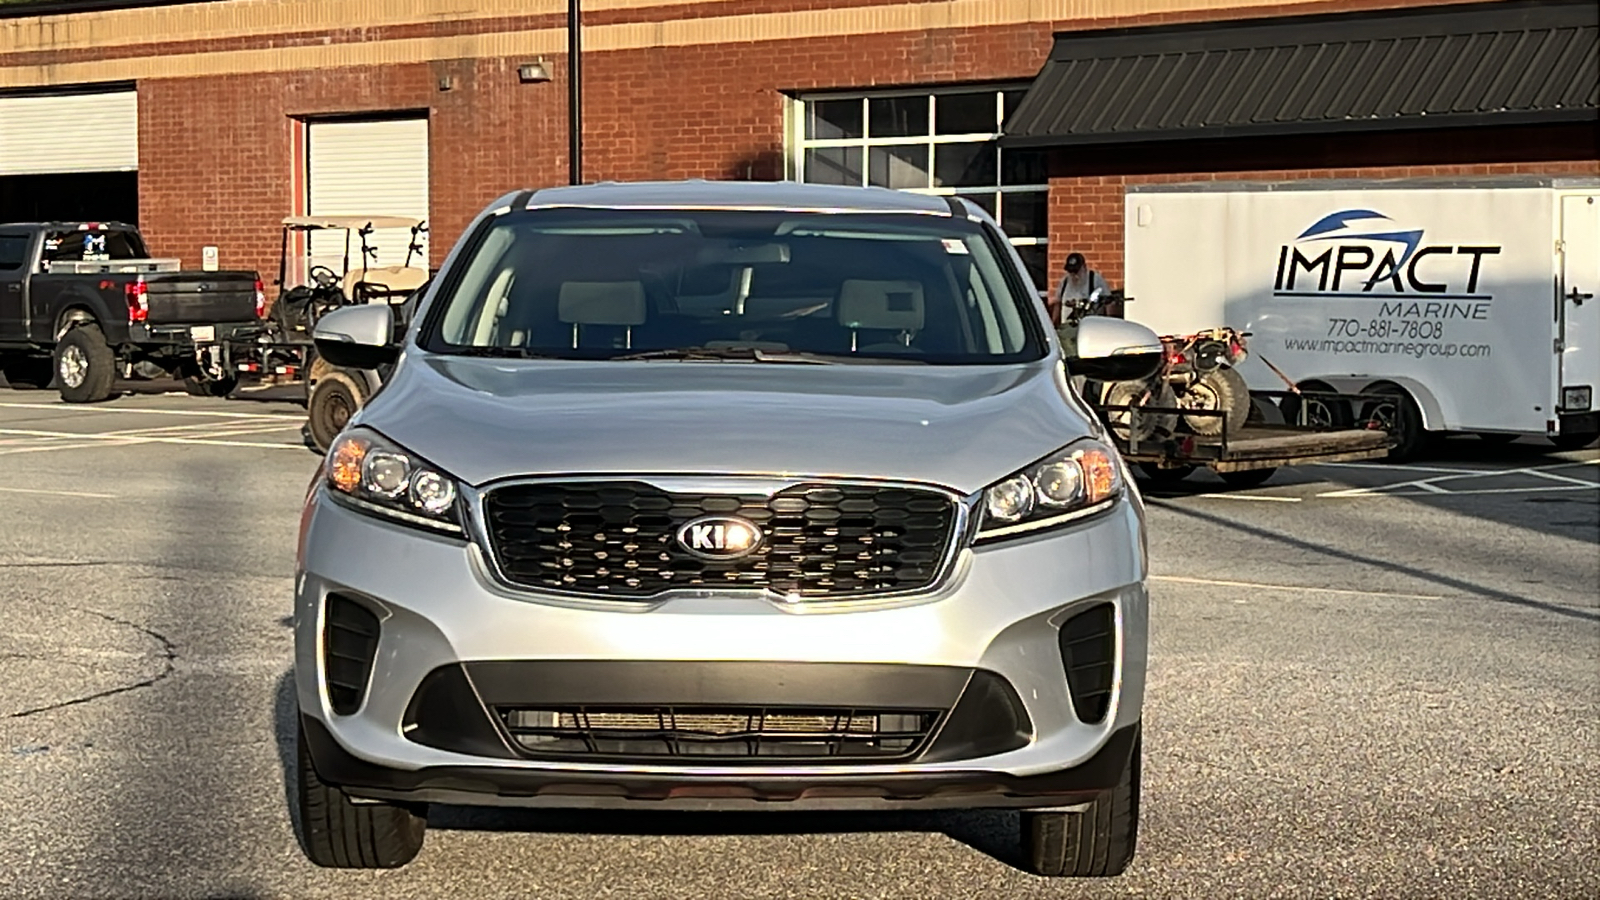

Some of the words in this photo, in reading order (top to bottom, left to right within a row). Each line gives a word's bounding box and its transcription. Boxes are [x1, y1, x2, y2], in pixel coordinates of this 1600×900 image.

[1273, 245, 1502, 294] IMPACT
[1379, 302, 1491, 320] MARINE
[1327, 318, 1443, 339] 770-881-7808
[1285, 338, 1491, 358] www.impactmarinegroup.com
